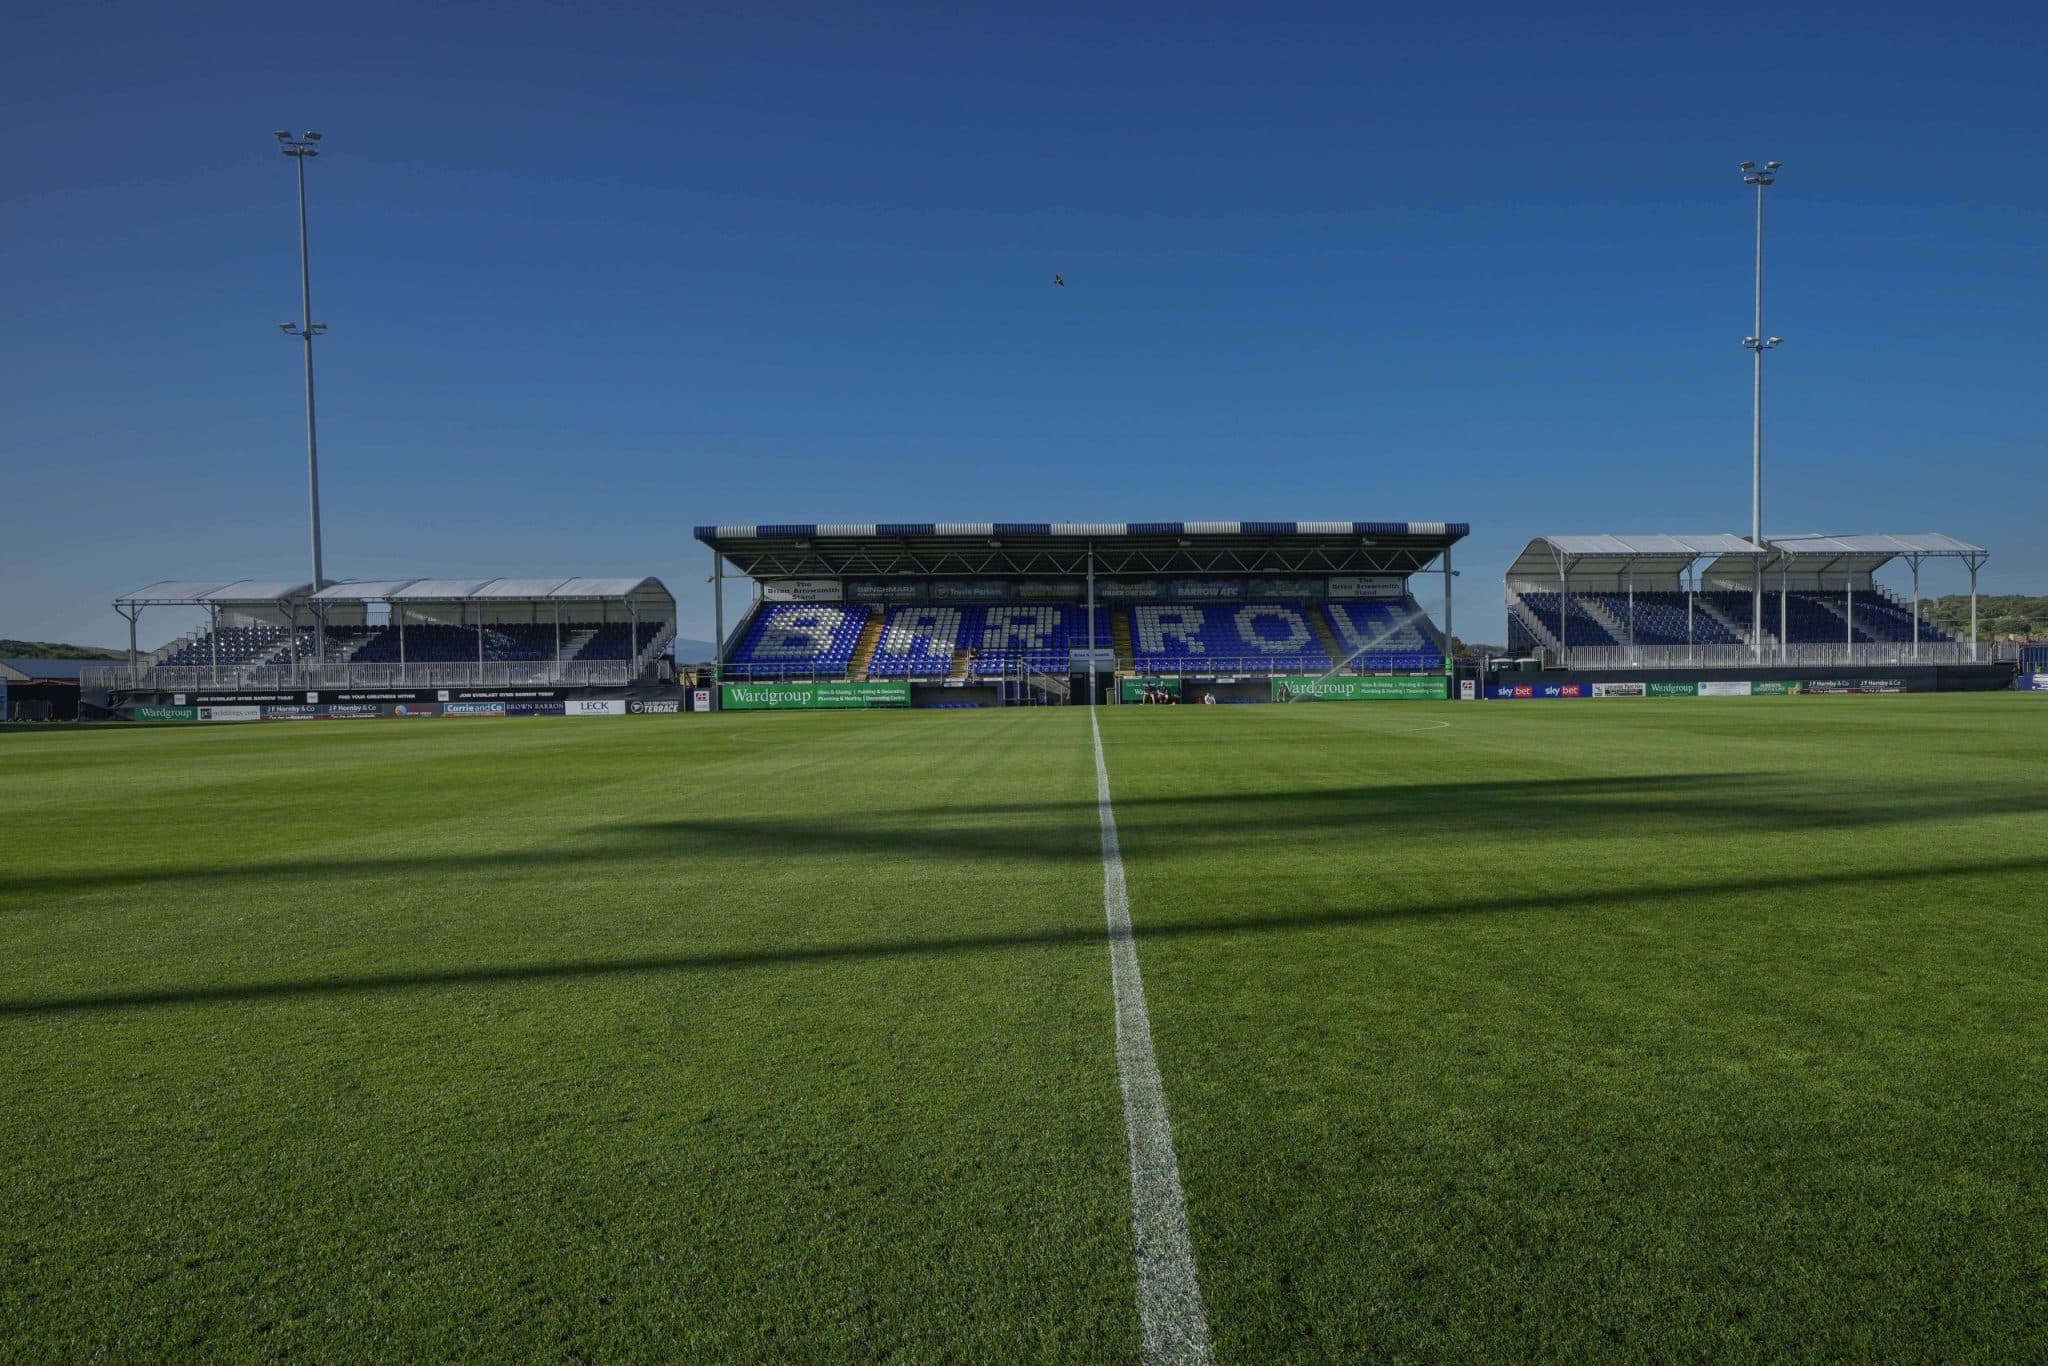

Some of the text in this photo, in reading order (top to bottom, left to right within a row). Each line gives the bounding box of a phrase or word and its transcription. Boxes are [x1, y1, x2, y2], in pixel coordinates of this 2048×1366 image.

[1177, 587, 1239, 596] BARROW AFC
[1498, 687, 1532, 696] sky bet
[1545, 686, 1578, 696] sky bet
[1651, 683, 1693, 694] Wardgroup
[731, 689, 811, 705] Wardgroup
[581, 702, 609, 710] LECK
[142, 707, 192, 719] Wardgroup
